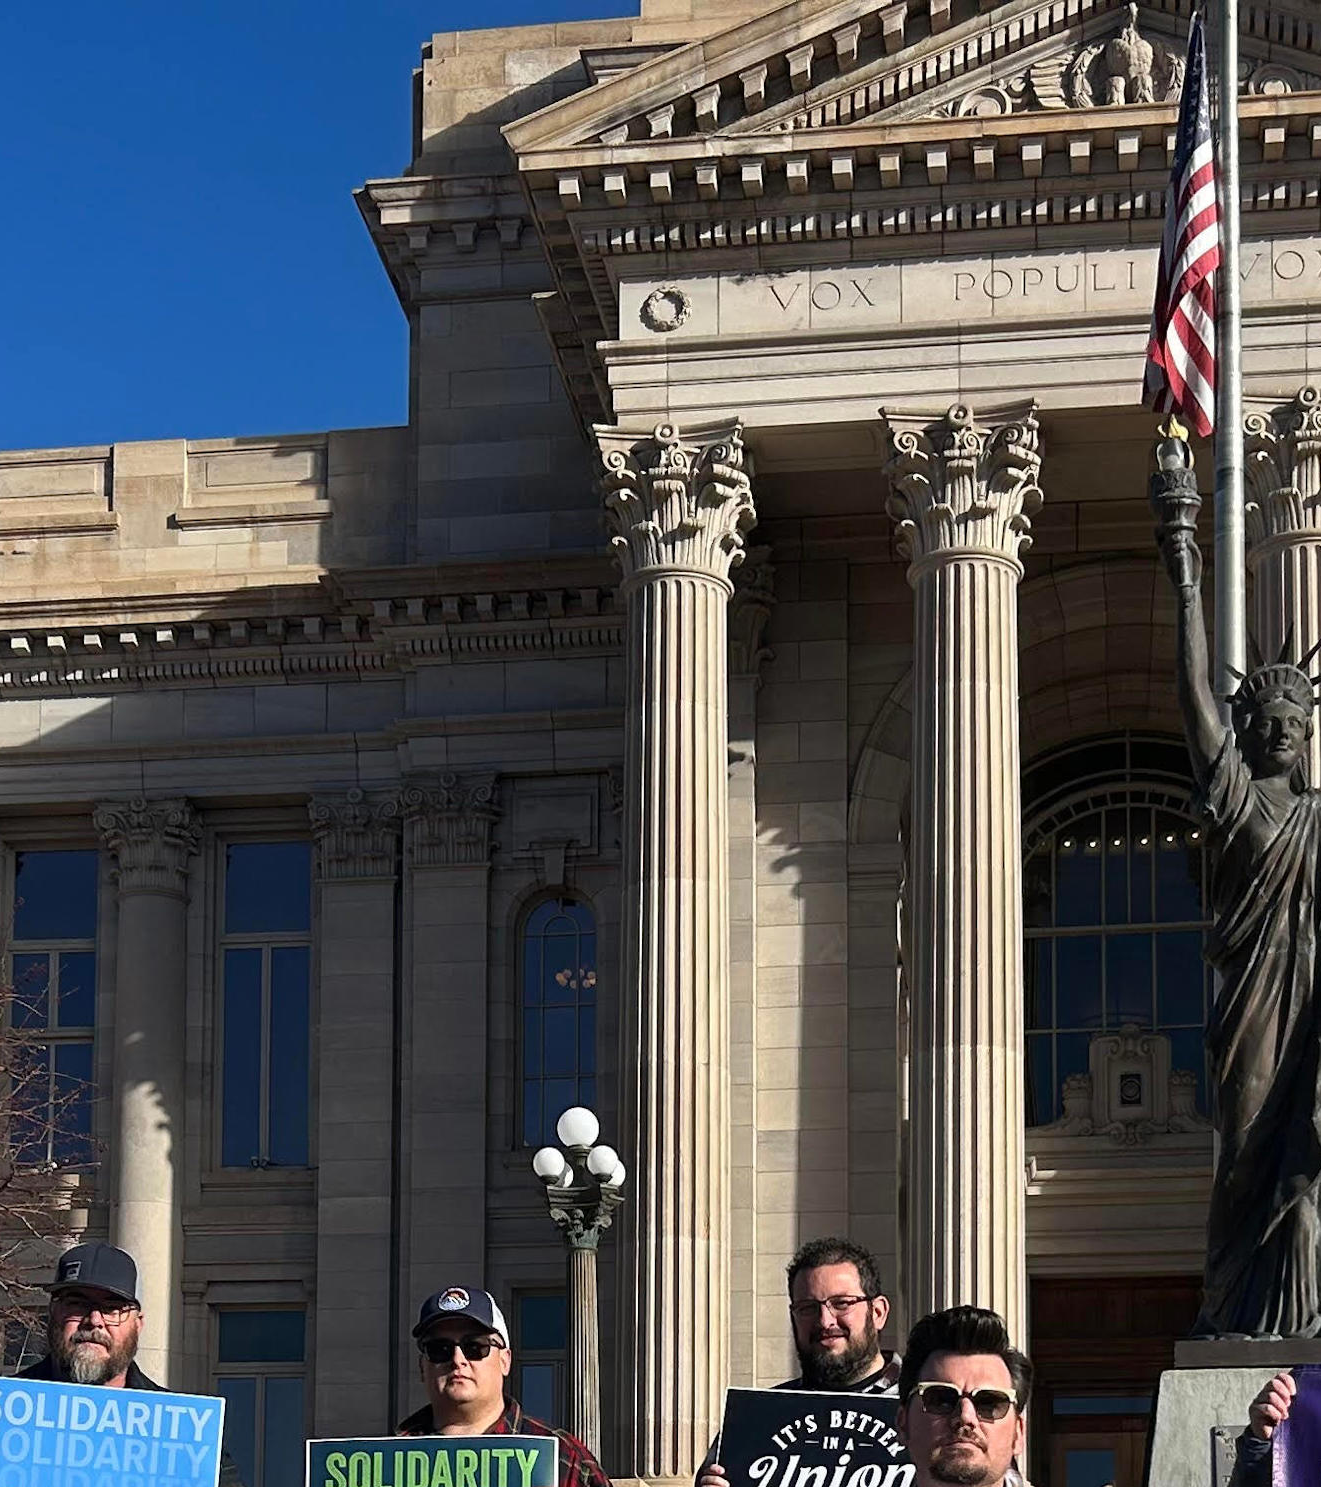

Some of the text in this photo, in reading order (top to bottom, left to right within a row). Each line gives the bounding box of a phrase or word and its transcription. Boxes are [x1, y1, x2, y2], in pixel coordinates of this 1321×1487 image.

[768, 278, 876, 311] VOX
[953, 260, 1136, 301] POPULI
[771, 1414, 818, 1451] IT'S
[822, 1436, 855, 1451] IN A
